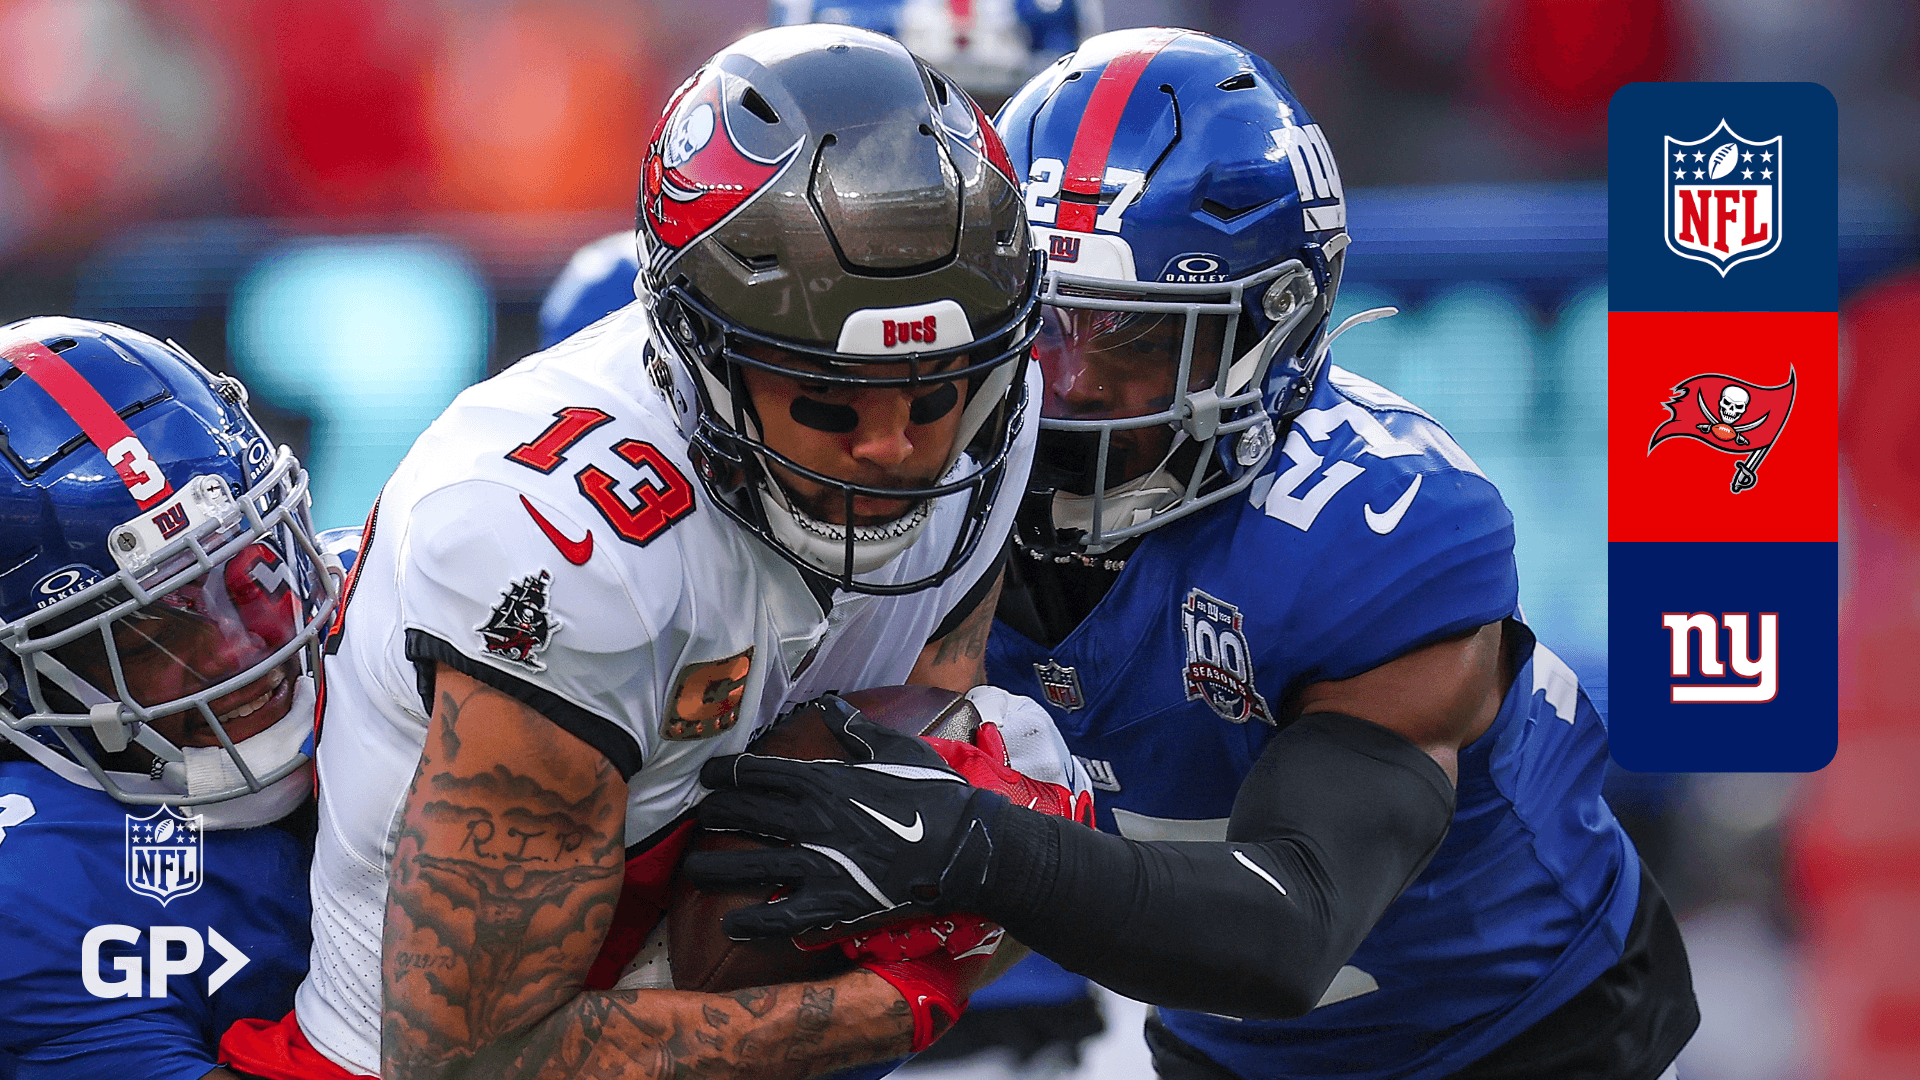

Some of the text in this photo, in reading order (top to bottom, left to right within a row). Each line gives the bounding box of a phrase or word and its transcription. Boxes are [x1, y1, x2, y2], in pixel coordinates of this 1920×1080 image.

[1049, 235, 1081, 263] ny
[1165, 273, 1226, 283] OAKLEY
[106, 436, 167, 502] 3
[504, 406, 697, 548] 13
[151, 501, 190, 541] ny
[36, 576, 98, 609] OAKLEY
[1184, 611, 1247, 684] 100
[1192, 666, 1247, 696] SEASONS
